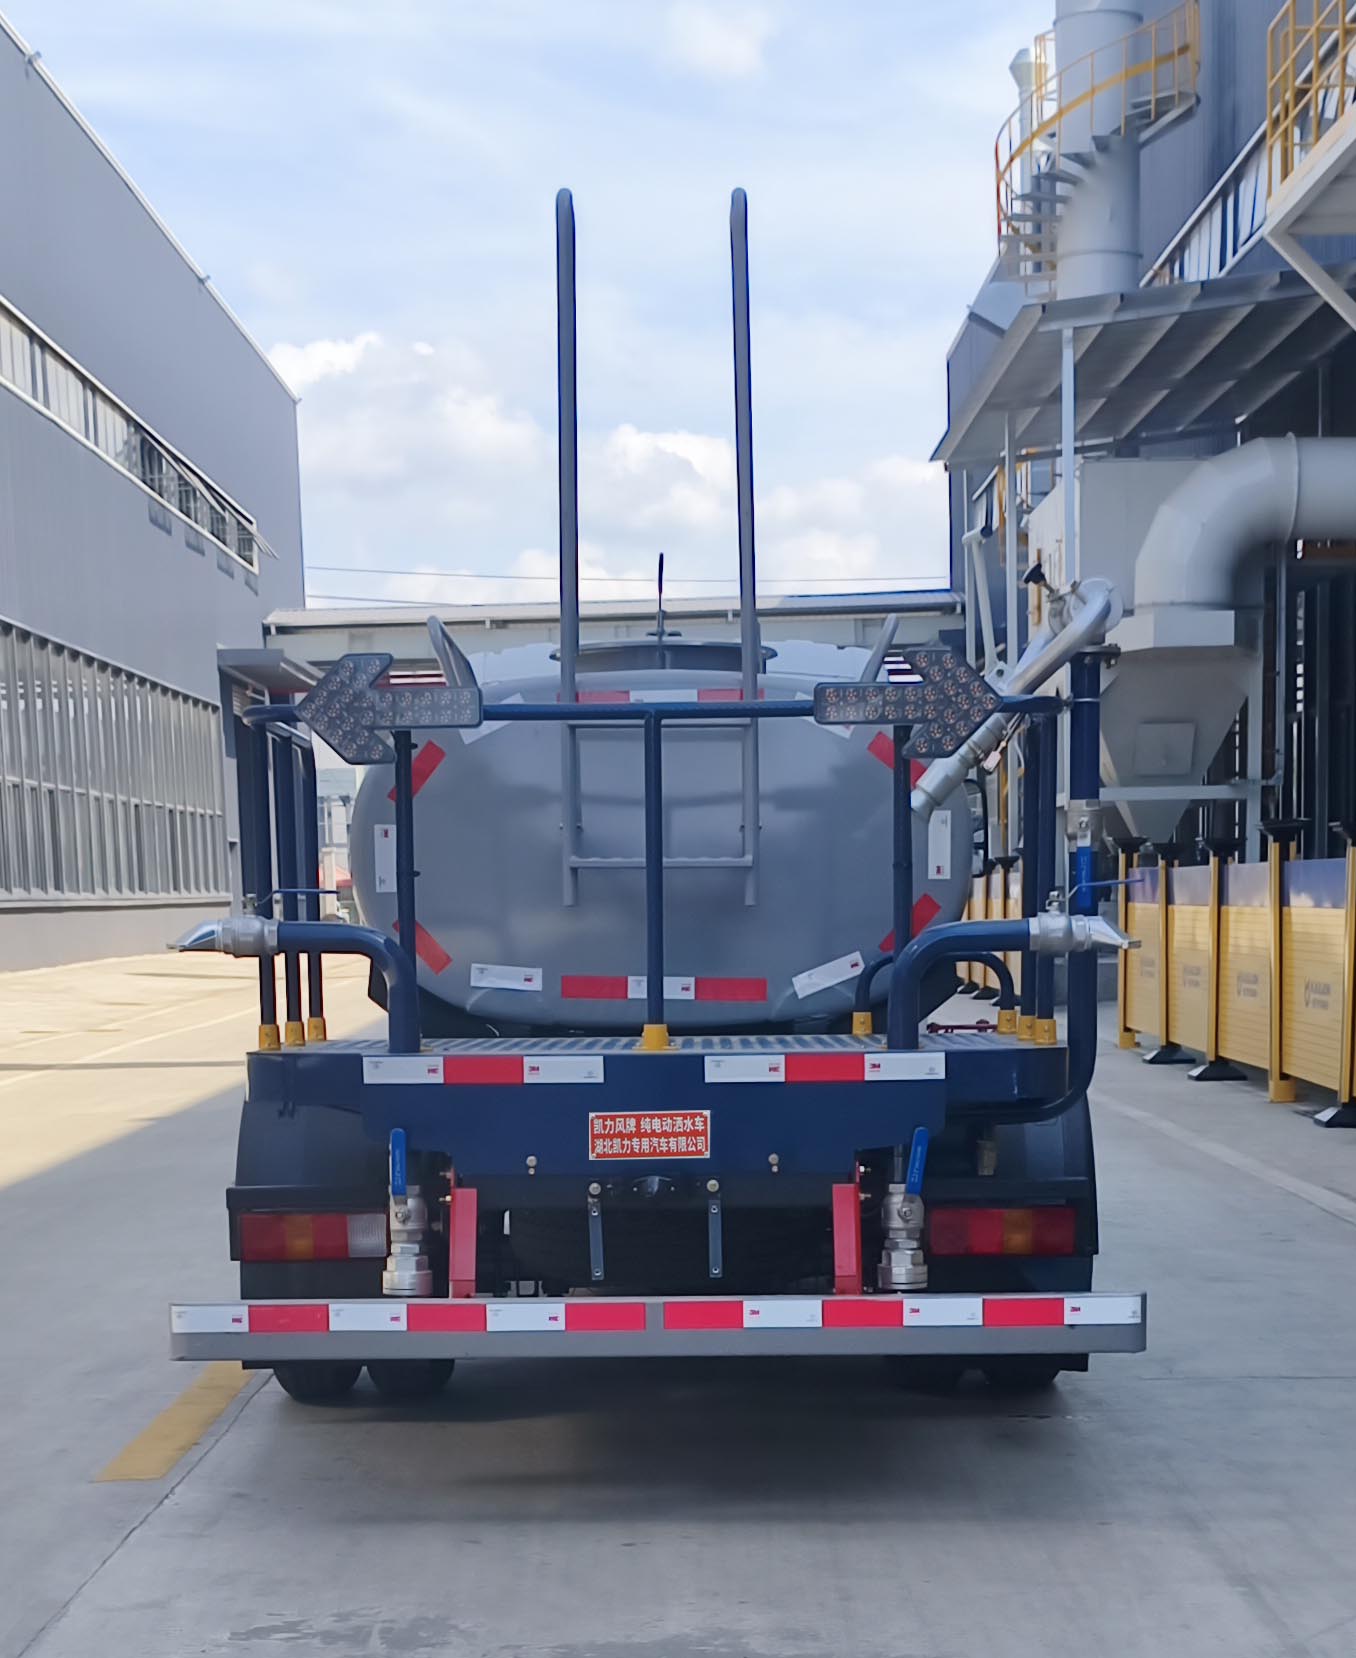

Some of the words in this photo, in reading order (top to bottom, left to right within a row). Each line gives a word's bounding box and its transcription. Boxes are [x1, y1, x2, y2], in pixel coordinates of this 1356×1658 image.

[594, 1118, 637, 1135] 凯力风牌
[641, 1116, 705, 1133] 纯电动洒水车
[594, 1136, 706, 1154] 湖北凯力专用汽车有限公司
